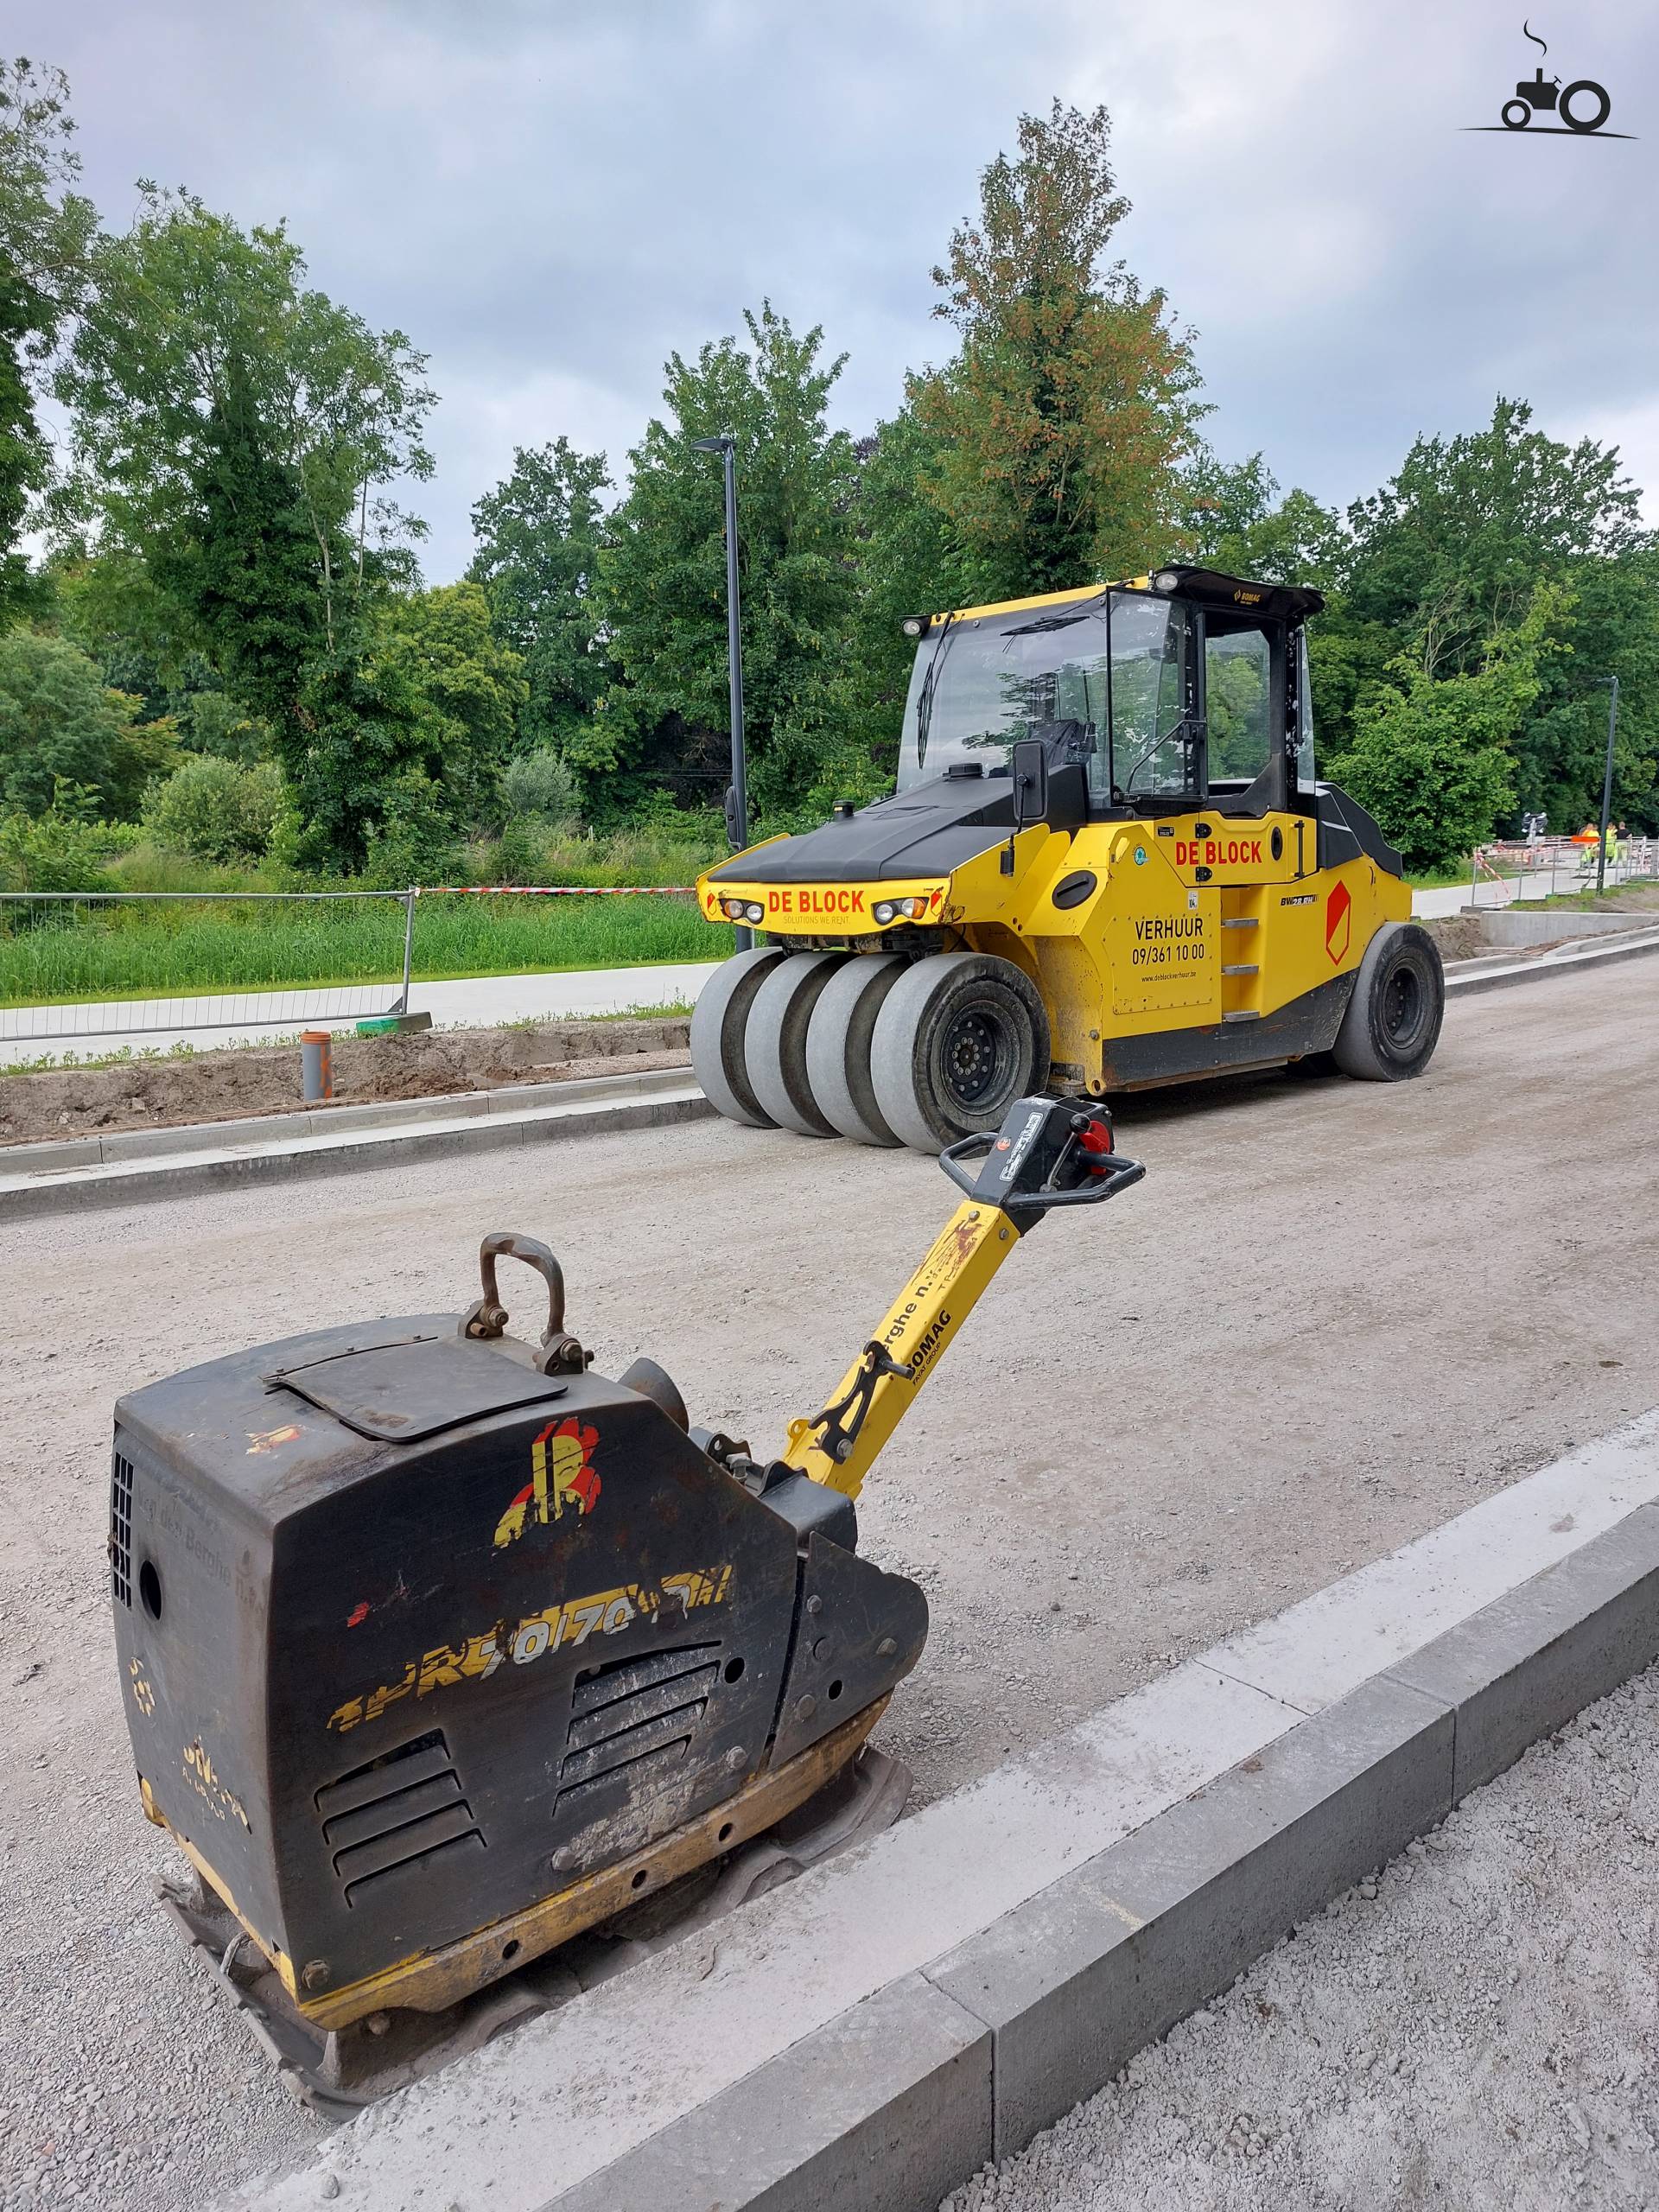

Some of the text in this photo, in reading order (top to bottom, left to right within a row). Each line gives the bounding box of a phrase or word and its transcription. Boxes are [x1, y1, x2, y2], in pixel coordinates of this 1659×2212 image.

[1241, 592, 1261, 602] BOMAG
[1176, 841, 1262, 866] DE BLOCK
[768, 890, 865, 913] DE BLOCK
[784, 916, 818, 925] SOLUTIONS
[1135, 918, 1204, 940] VERHUUR
[1132, 944, 1205, 965] 09/361 10 00
[1141, 971, 1197, 982] www.deblockverhuur.be
[912, 1342, 941, 1386] FAYAT GROUP
